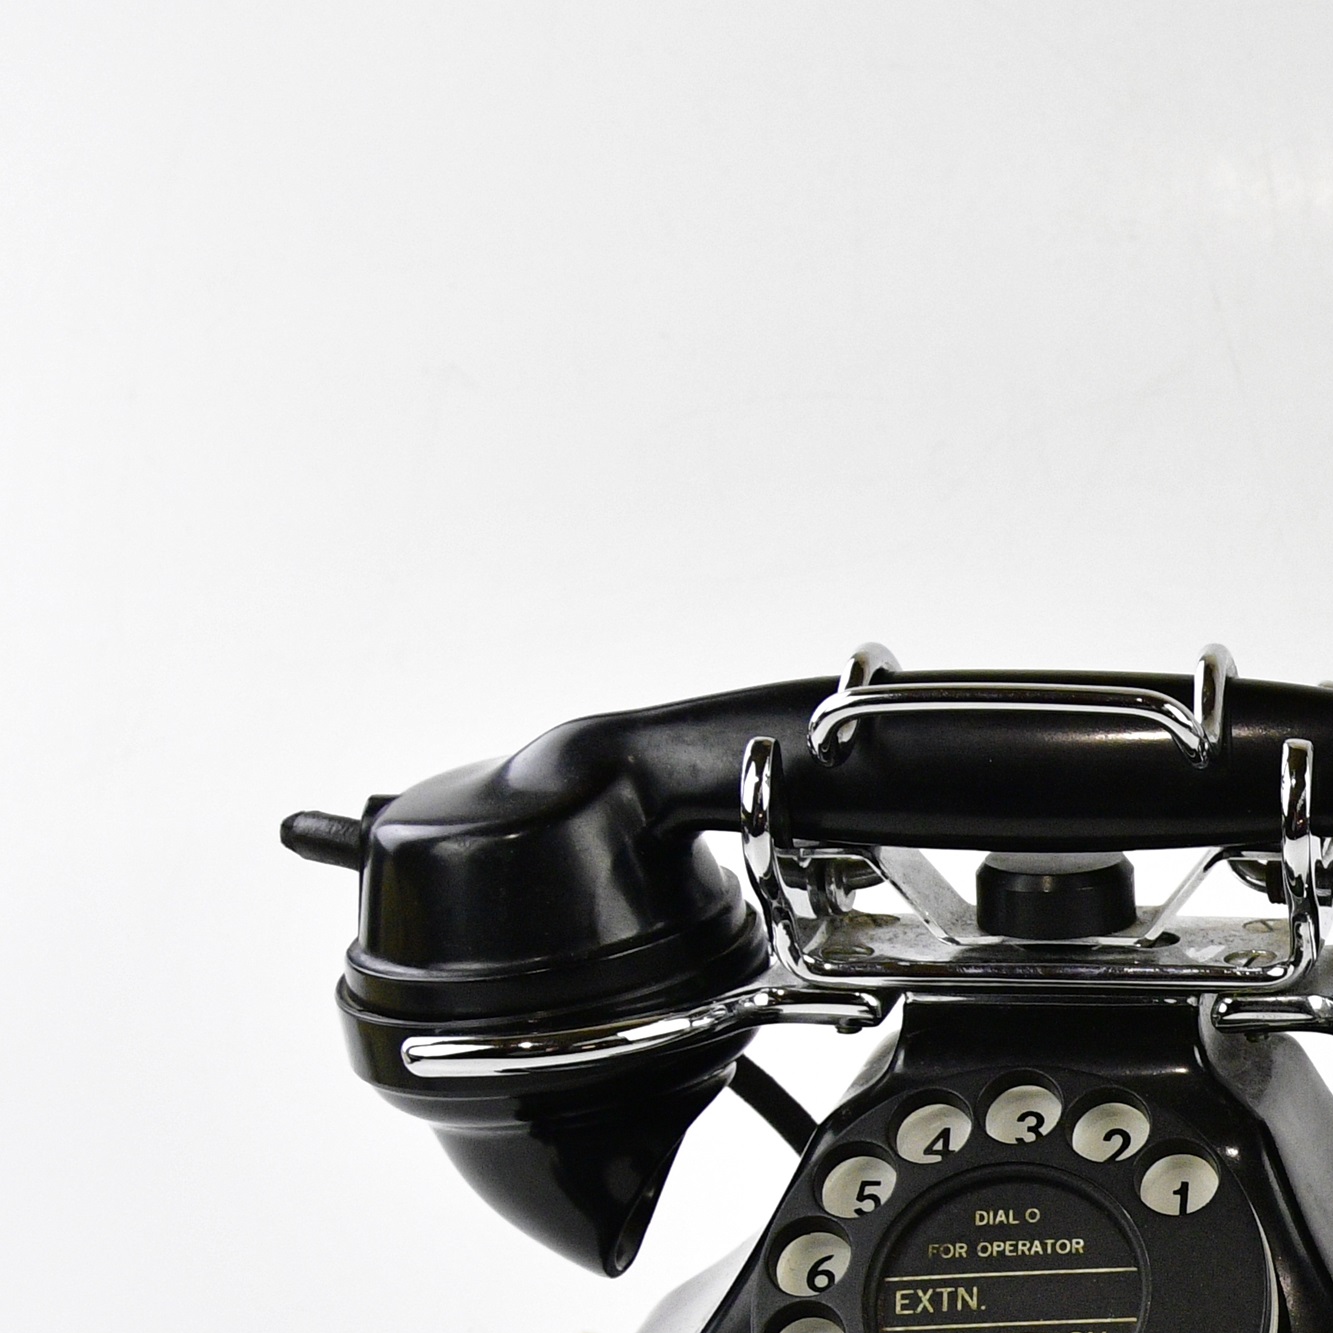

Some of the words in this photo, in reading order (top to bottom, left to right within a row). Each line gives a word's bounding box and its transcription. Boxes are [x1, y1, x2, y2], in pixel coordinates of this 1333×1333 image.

[923, 1127, 956, 1161] 4
[1015, 1111, 1045, 1144] 3
[1103, 1128, 1131, 1162] 2
[854, 1180, 882, 1216] 5
[1173, 1181, 1189, 1215] 1
[975, 1209, 1020, 1226] DIAL
[928, 1243, 967, 1258] FOR
[977, 1238, 1085, 1257] OPERATOR
[806, 1254, 835, 1293] 6
[895, 1286, 986, 1315] EXTN.
